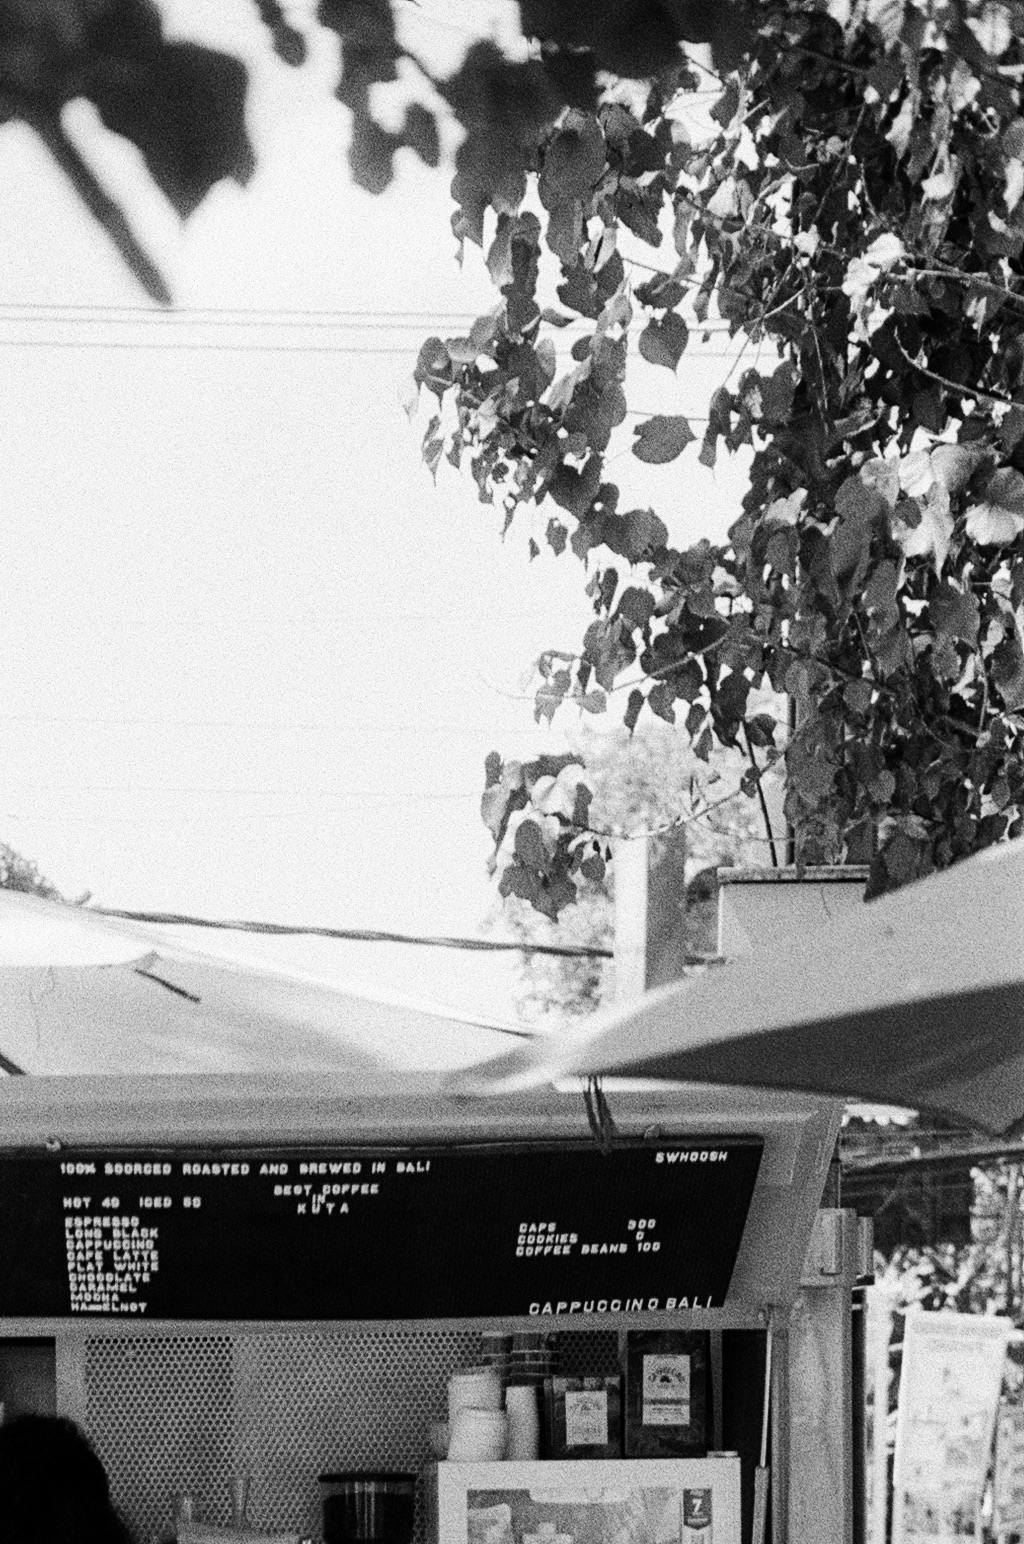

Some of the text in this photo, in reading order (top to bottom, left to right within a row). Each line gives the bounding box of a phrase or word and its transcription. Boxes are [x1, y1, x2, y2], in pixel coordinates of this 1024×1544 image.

[654, 1150, 728, 1165] SWHOOSH
[60, 1160, 431, 1175] 100% SOURCED ROASTED AND BREWED IN BALI
[273, 1183, 380, 1197] BEST COFFEE
[62, 1196, 92, 1209] HOT
[139, 1196, 173, 1209] ICED
[311, 1194, 327, 1205] IN
[64, 1216, 140, 1228] ESPRESSO
[65, 1227, 159, 1239] LONG BLACK
[519, 1222, 557, 1235] CAPS
[66, 1239, 155, 1251] CAPPUCCINO
[517, 1233, 578, 1246] COOKIES
[66, 1251, 159, 1262] CAFE LATTE
[515, 1245, 572, 1258] COFFEE
[580, 1243, 628, 1256] BEANS
[67, 1261, 160, 1272] FLAT WHITE
[68, 1272, 151, 1283] CHOCOLATE
[69, 1283, 137, 1293] CARAMEL
[70, 1292, 120, 1303] MOCHA
[528, 1295, 713, 1316] CAPPUCCINO BALI
